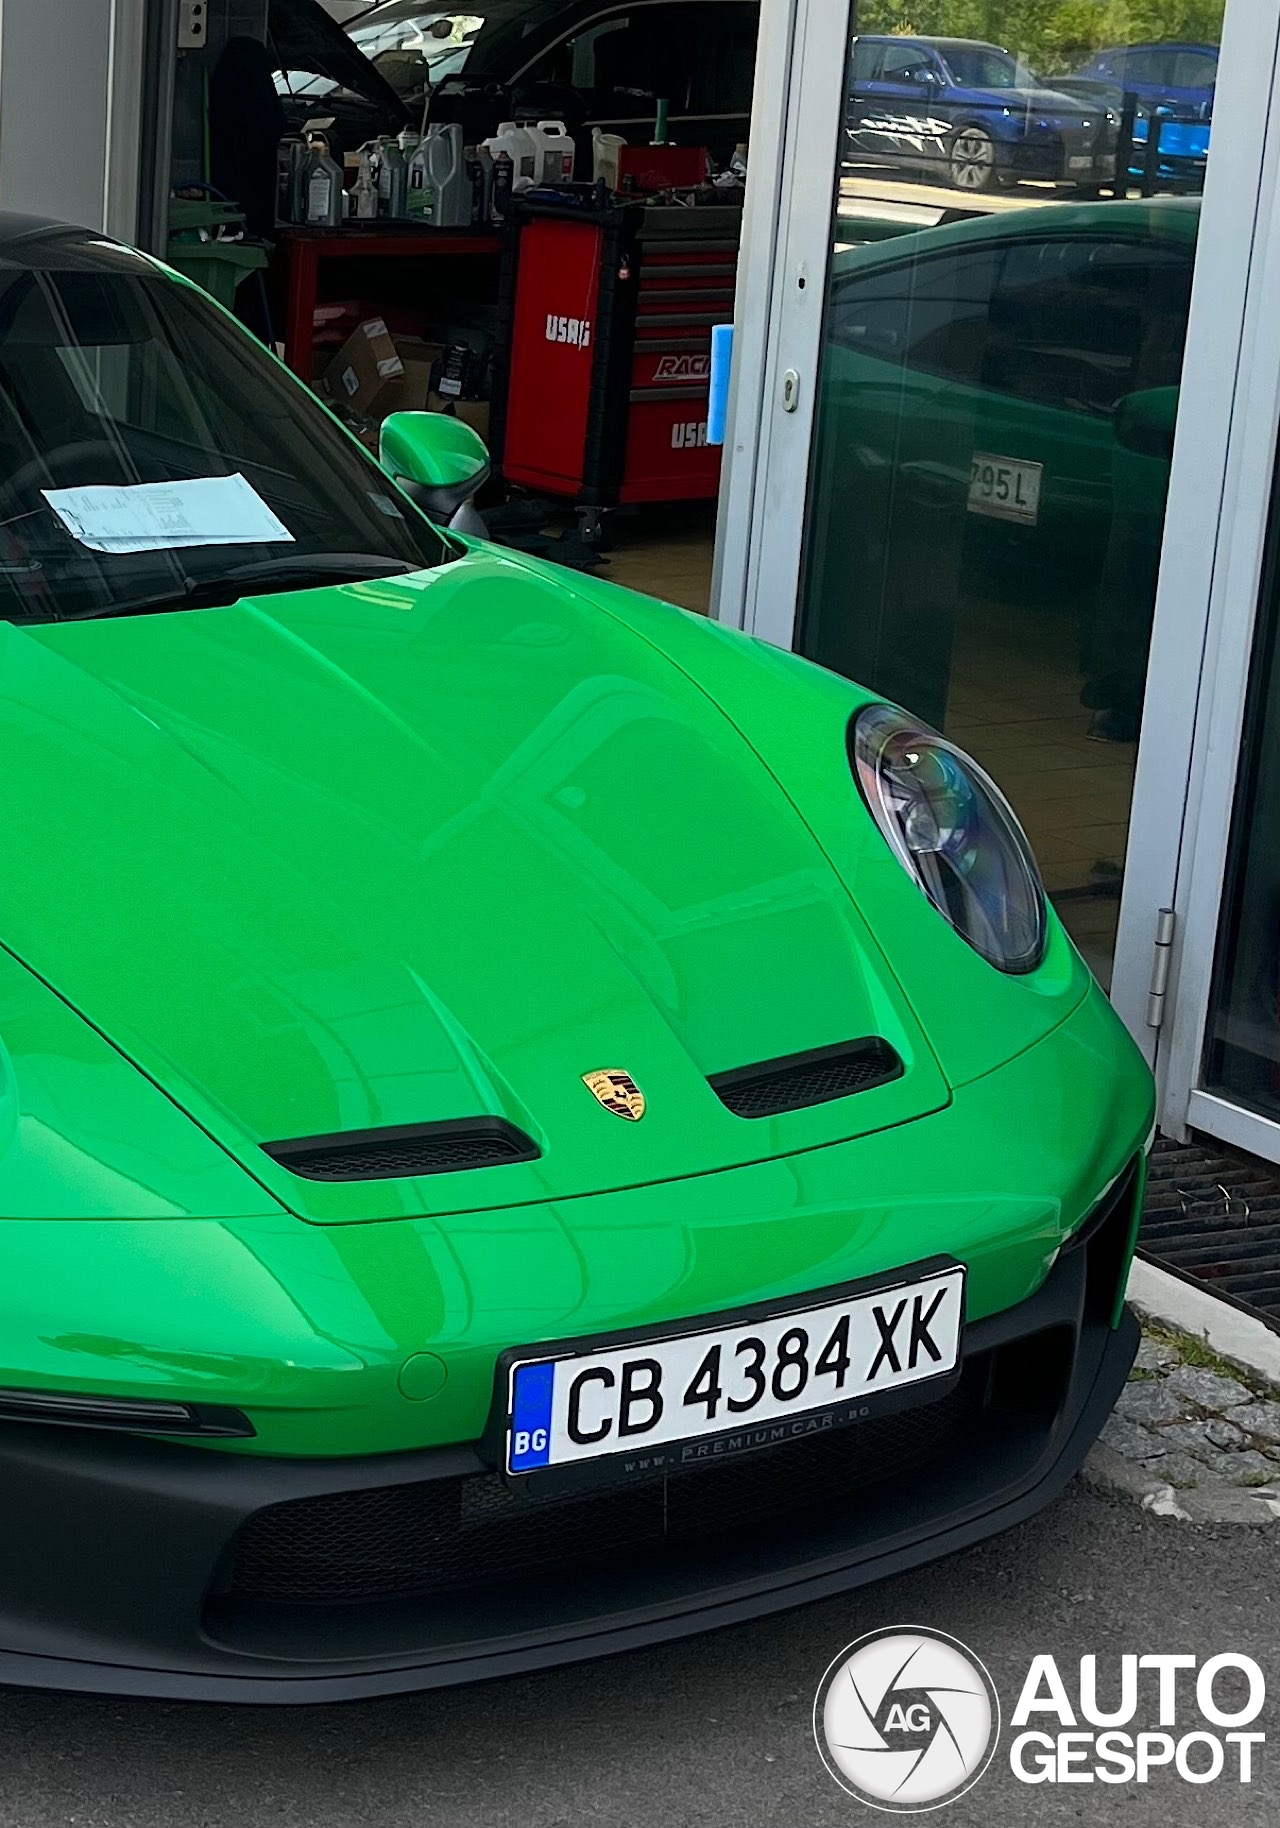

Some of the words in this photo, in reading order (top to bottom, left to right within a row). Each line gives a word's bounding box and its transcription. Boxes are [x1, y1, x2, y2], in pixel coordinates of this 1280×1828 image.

[567, 1358, 663, 1445] CB
[683, 1314, 851, 1420] 4384
[866, 1287, 948, 1381] XK
[514, 1428, 548, 1456] BG
